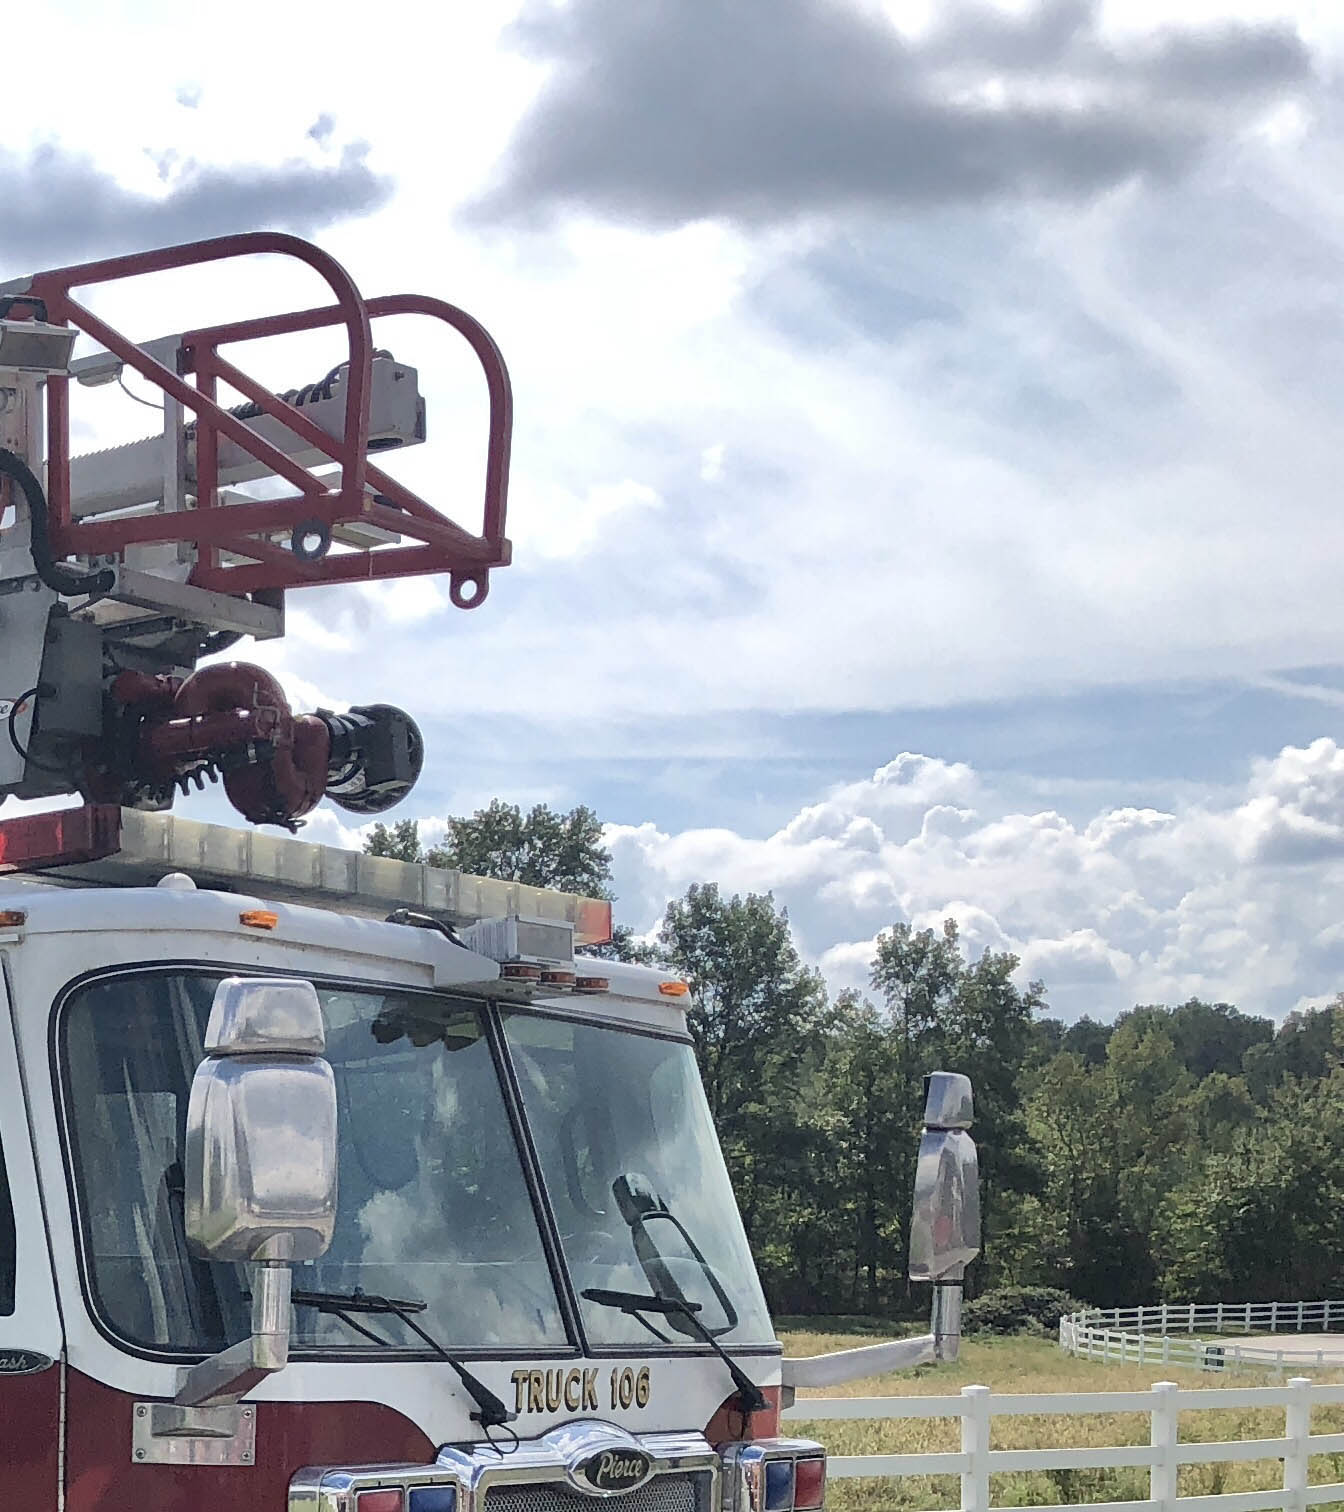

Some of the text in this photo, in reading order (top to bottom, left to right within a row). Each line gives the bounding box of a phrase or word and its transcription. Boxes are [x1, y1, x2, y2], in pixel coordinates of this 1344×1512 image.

[511, 1366, 650, 1413] TRUCK 106
[596, 1451, 643, 1486] Pierce
